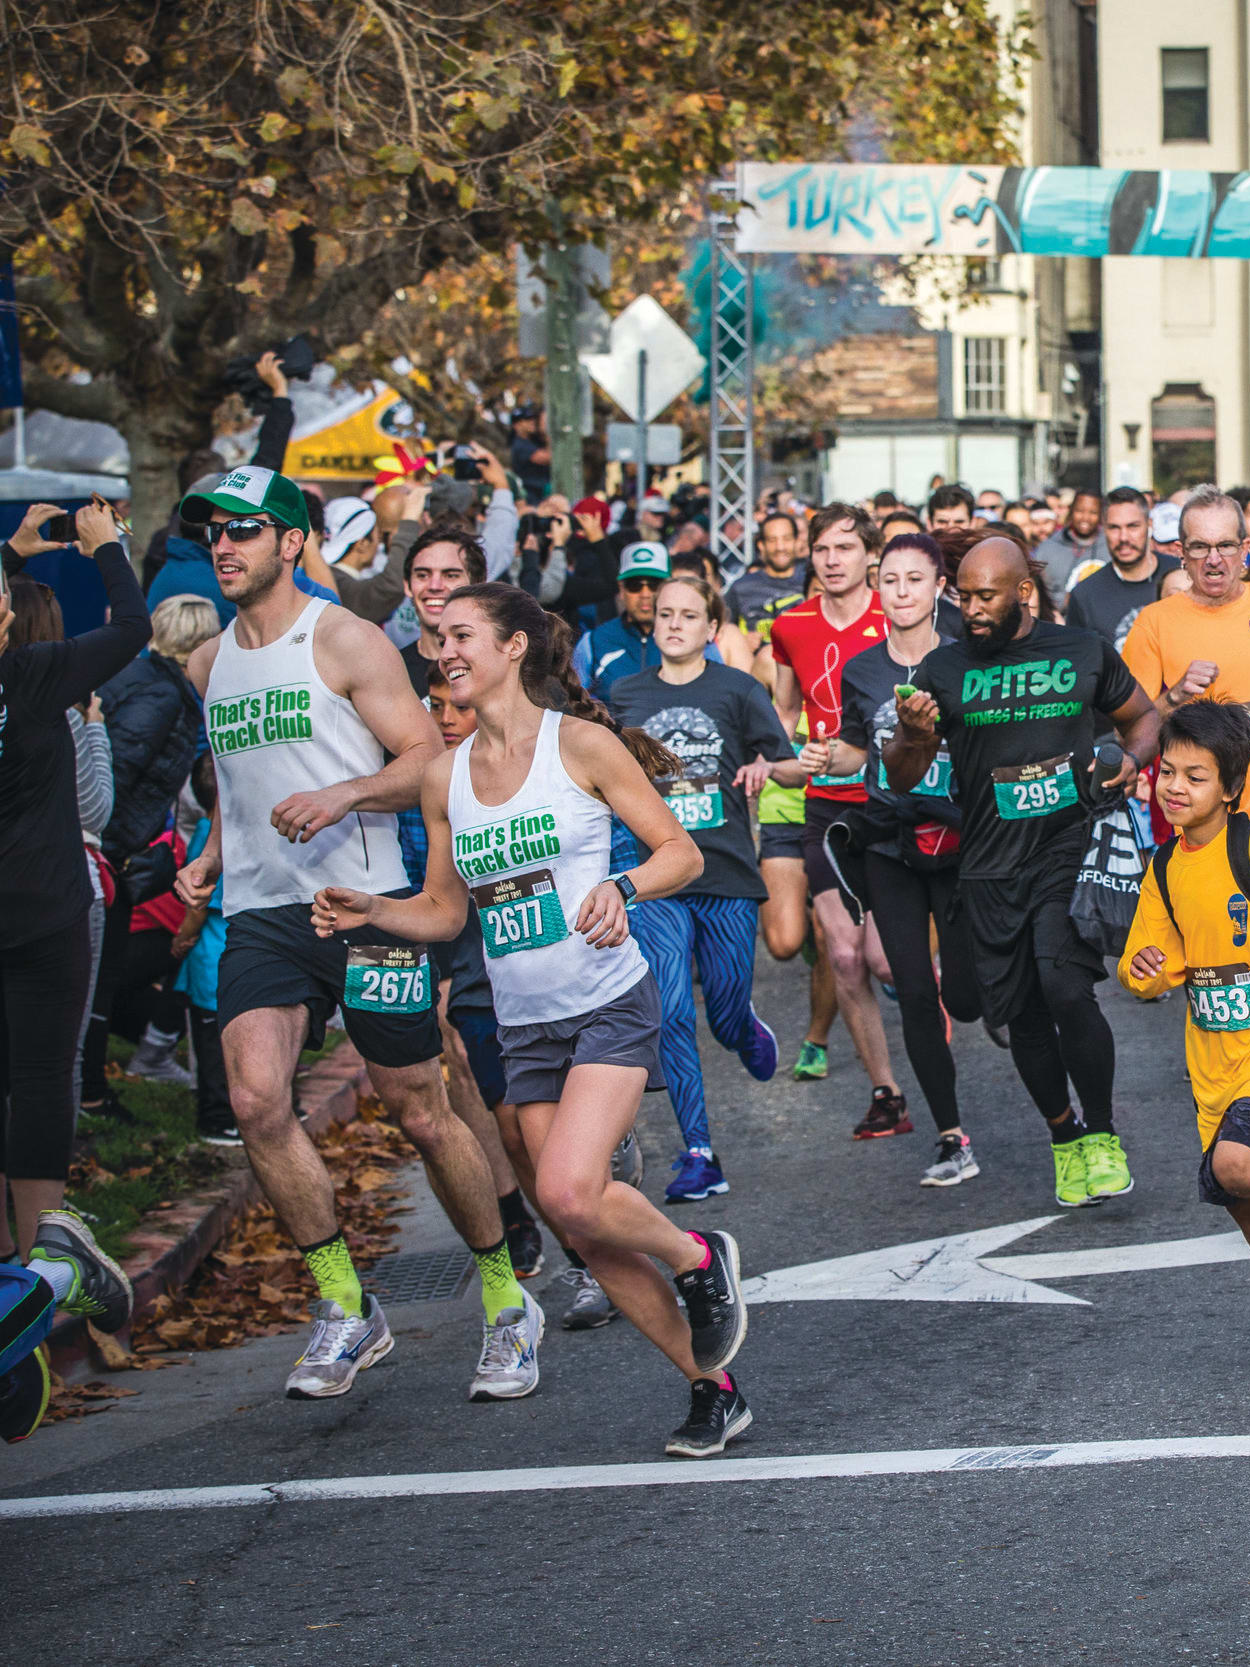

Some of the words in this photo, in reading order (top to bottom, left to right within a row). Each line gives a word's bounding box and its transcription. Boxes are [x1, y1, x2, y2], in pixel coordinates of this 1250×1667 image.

[758, 164, 961, 246] TURKEY
[209, 697, 261, 729] That's
[265, 689, 310, 715] Fine
[963, 707, 1011, 728] FITNESS
[209, 721, 261, 754] Track
[263, 712, 313, 742] Club
[1013, 778, 1060, 810] 295
[455, 826, 505, 857] That's
[510, 813, 556, 842] Fine
[456, 848, 509, 879] Track
[509, 834, 561, 865] Club
[487, 898, 543, 946] 2677
[361, 969, 424, 1004] 2676
